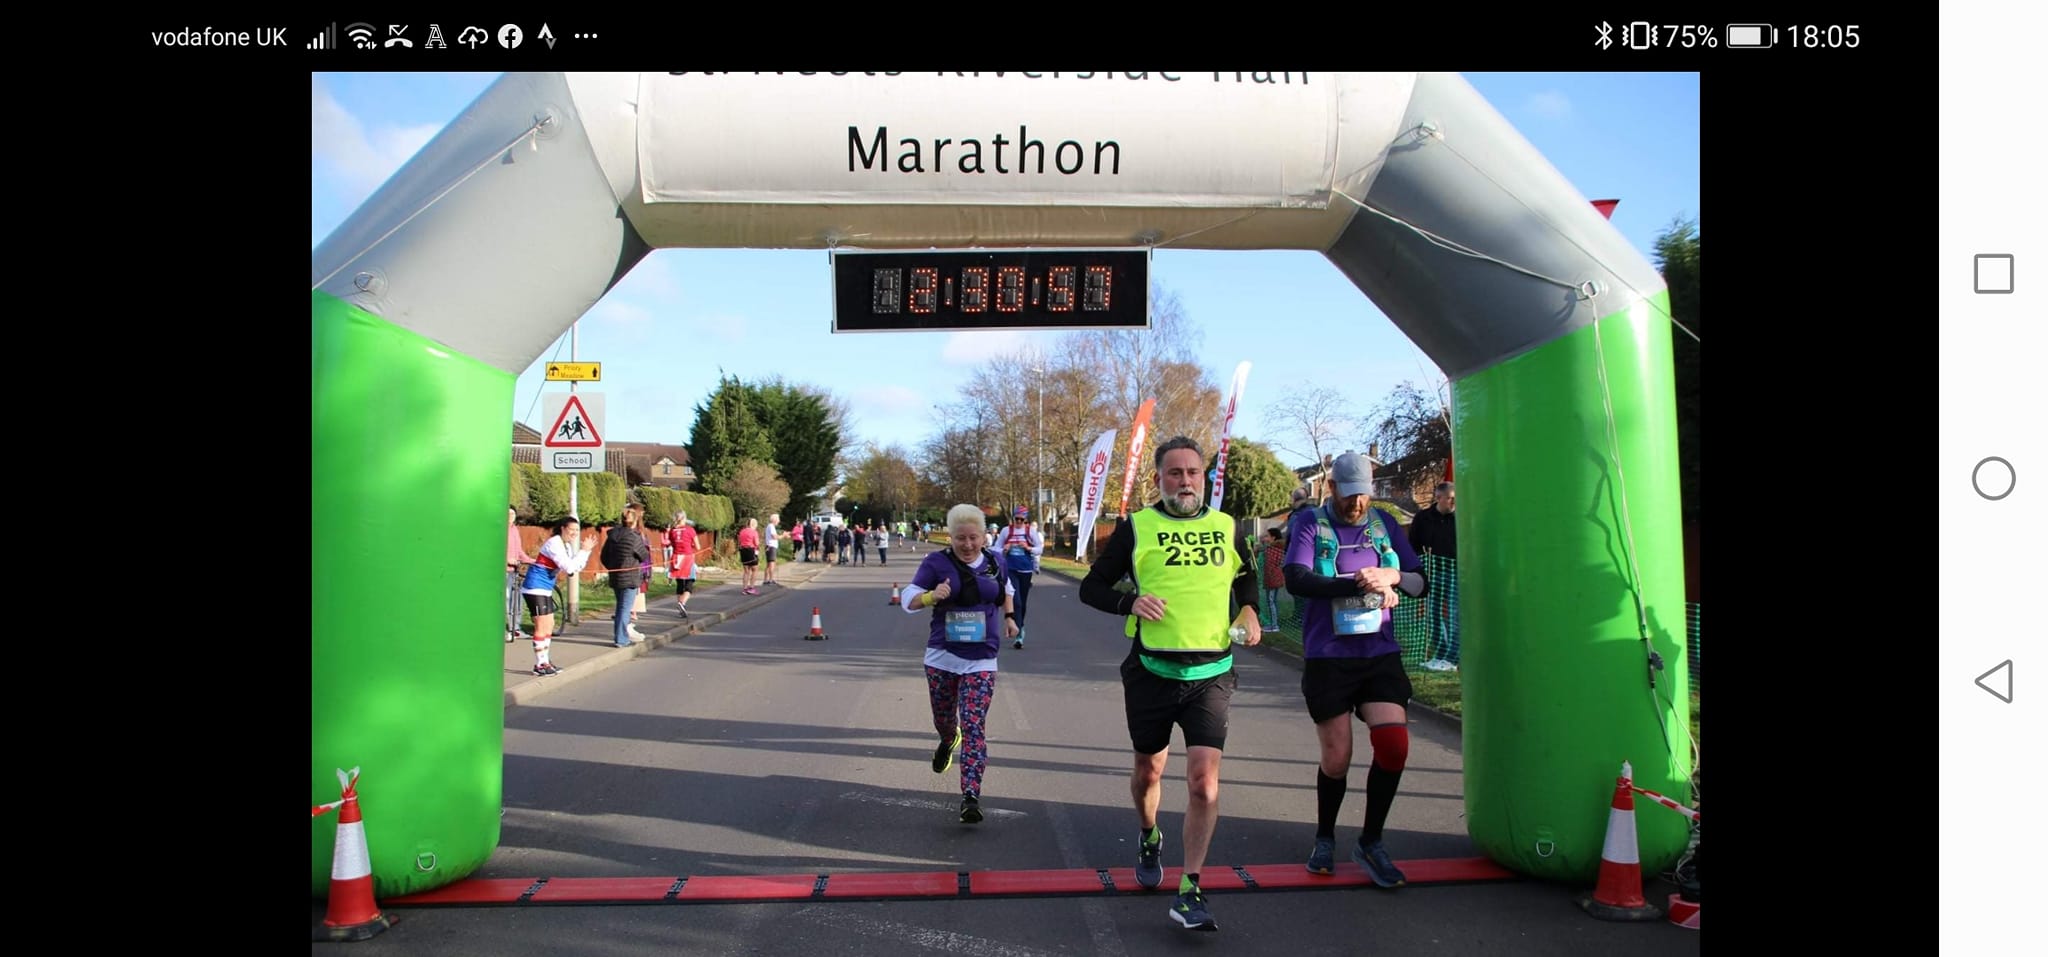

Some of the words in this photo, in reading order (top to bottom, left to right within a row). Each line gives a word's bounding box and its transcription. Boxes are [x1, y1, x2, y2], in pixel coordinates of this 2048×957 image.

[848, 125, 1121, 175] Marathon
[557, 456, 588, 465] School
[1084, 449, 1108, 512] HIGH5
[1157, 531, 1226, 547] PACER
[1164, 546, 1226, 567] 2:30
